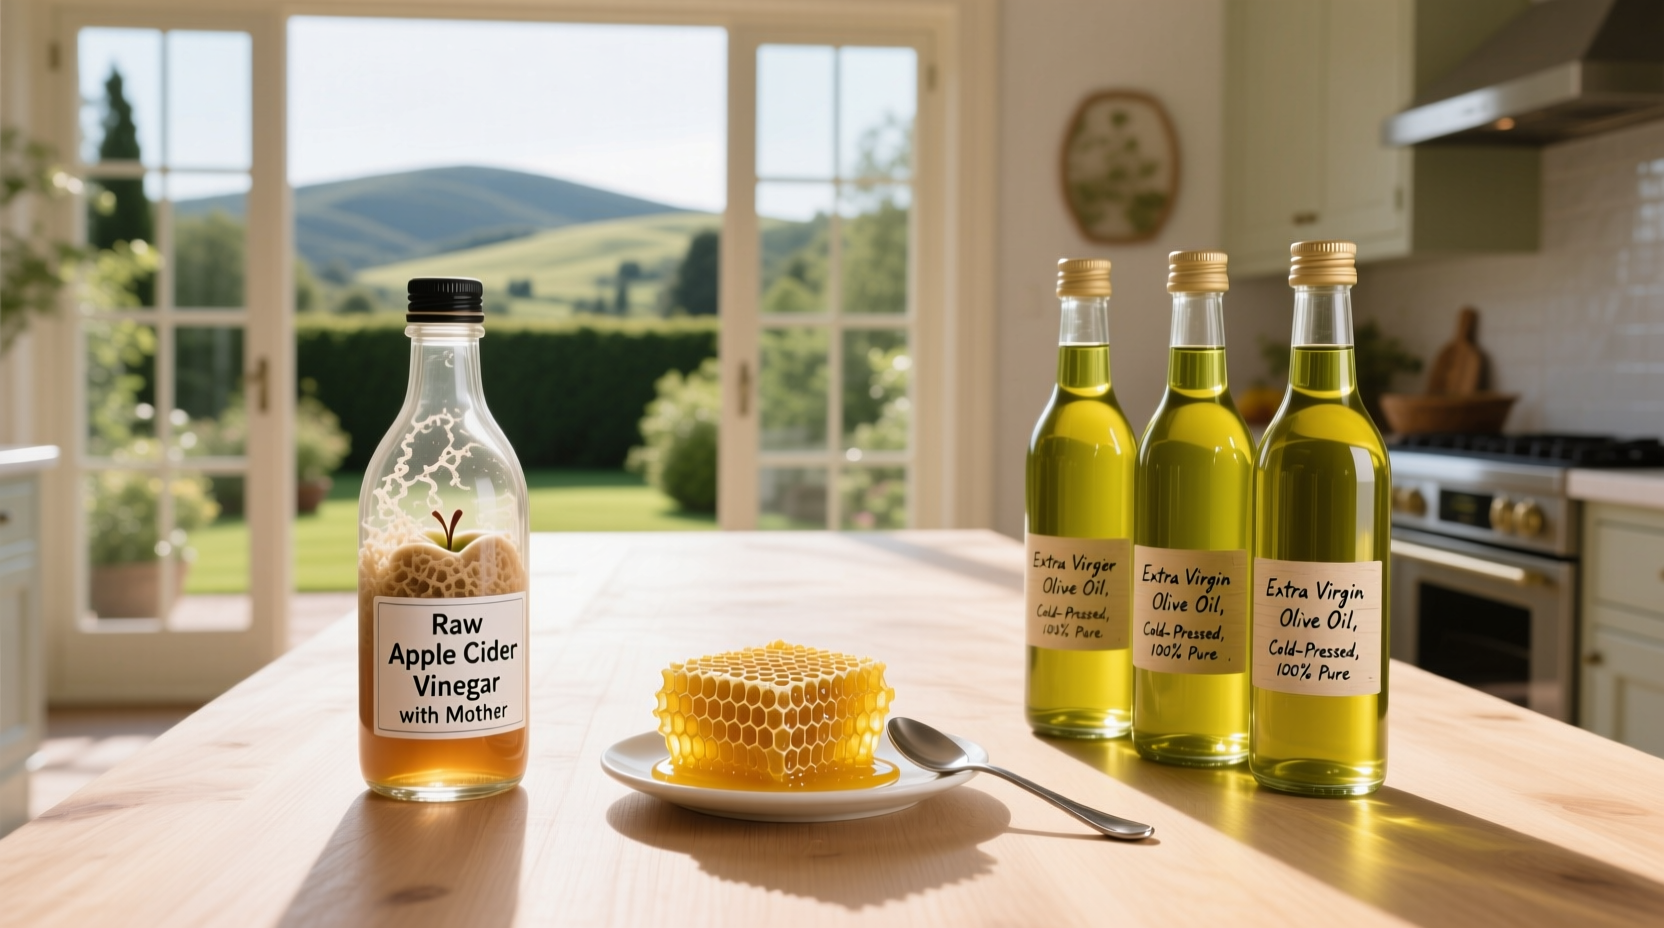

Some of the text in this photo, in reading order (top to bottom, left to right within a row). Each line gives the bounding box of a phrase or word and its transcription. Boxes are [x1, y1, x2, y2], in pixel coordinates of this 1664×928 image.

[1033, 551, 1066, 570] Extra
[1043, 576, 1109, 597] Olive Oil,
[1142, 564, 1231, 593] Extra Virgin
[1266, 577, 1364, 608] Extra Virgin
[1152, 592, 1224, 616] Olive Oil,
[433, 613, 483, 635] Raw
[1280, 607, 1357, 632] Olive Oil,
[1143, 621, 1224, 642] Cold-Pressed,
[388, 639, 518, 671] Apple Cider
[1151, 643, 1182, 659] 100%
[1269, 639, 1359, 661] Cold-Pressed,
[1276, 662, 1351, 681] 100% Pure
[413, 674, 501, 701] Vinegar
[399, 704, 508, 724] with Mother
